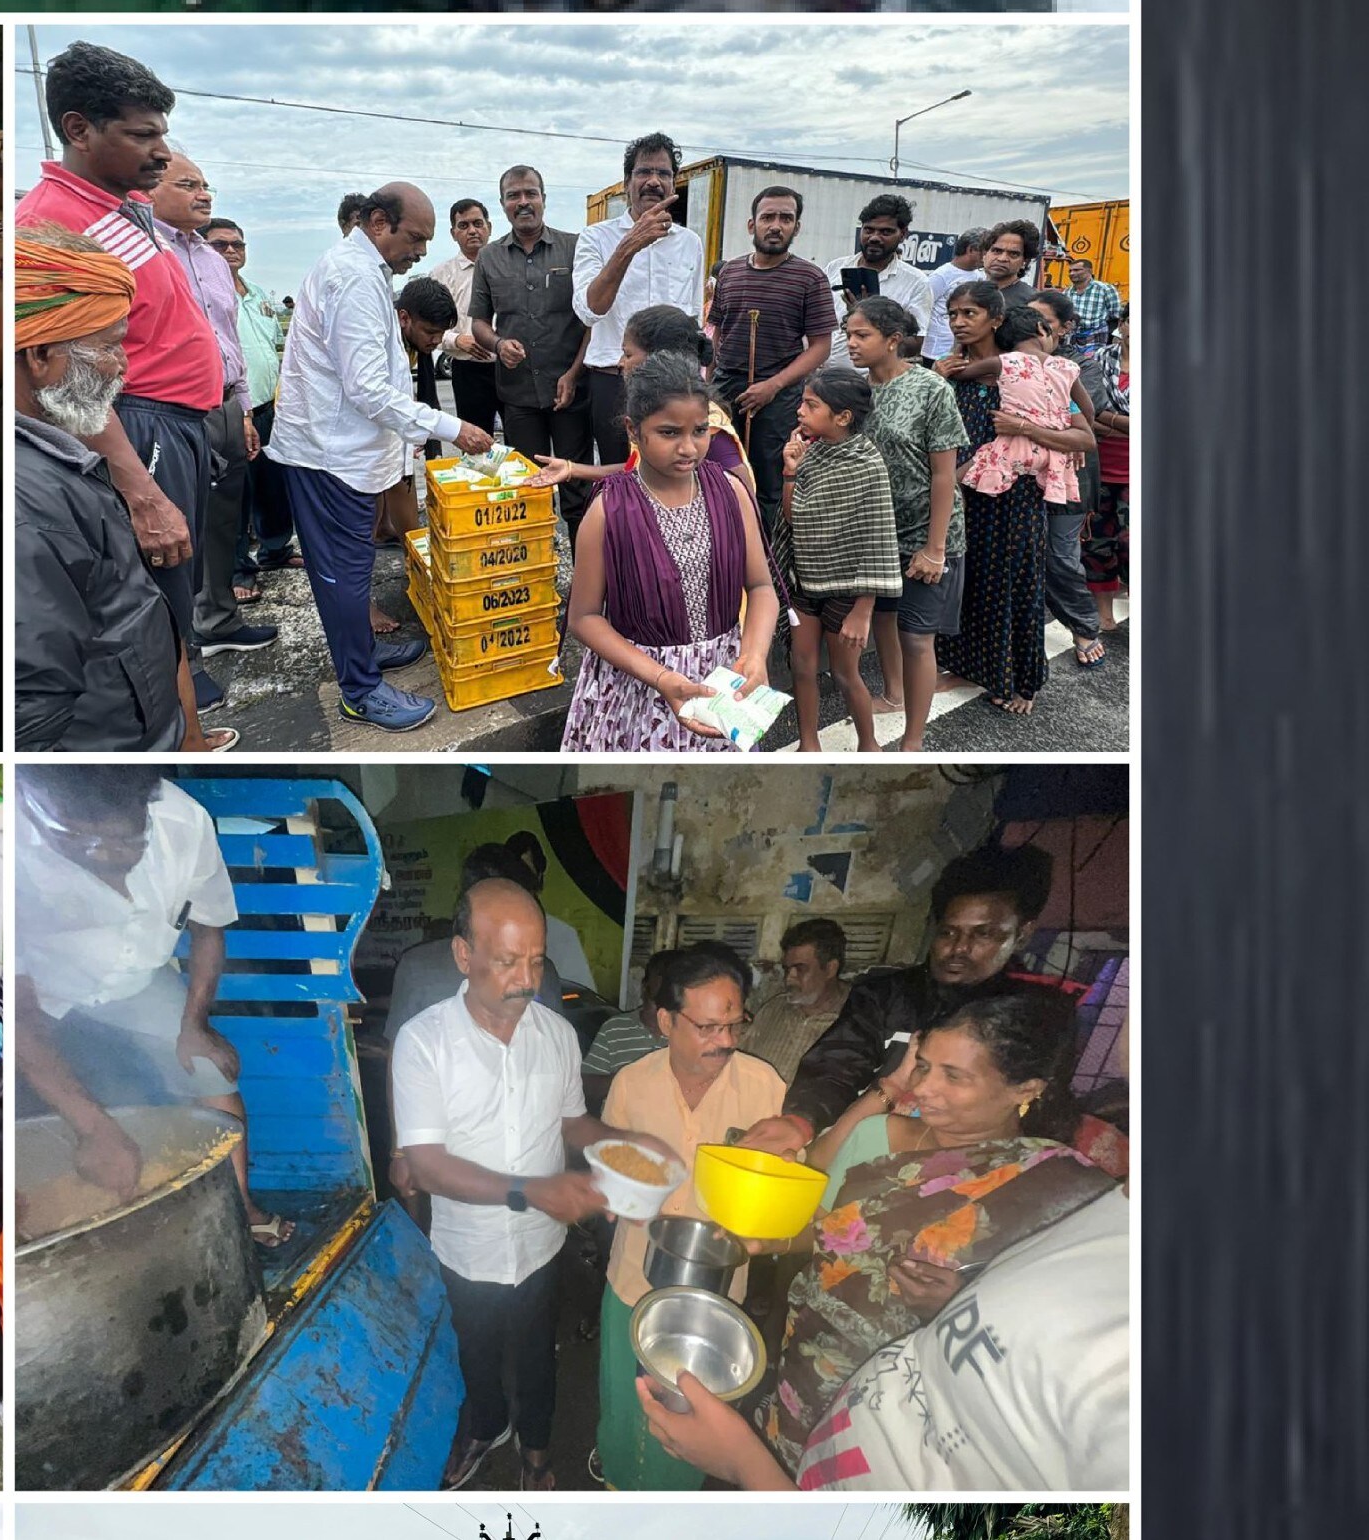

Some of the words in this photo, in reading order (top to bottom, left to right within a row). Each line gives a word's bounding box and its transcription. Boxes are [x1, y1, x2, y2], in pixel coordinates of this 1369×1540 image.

[899, 233, 943, 265] வின்
[474, 502, 527, 526] 01/2022
[482, 587, 530, 611] 06/2023
